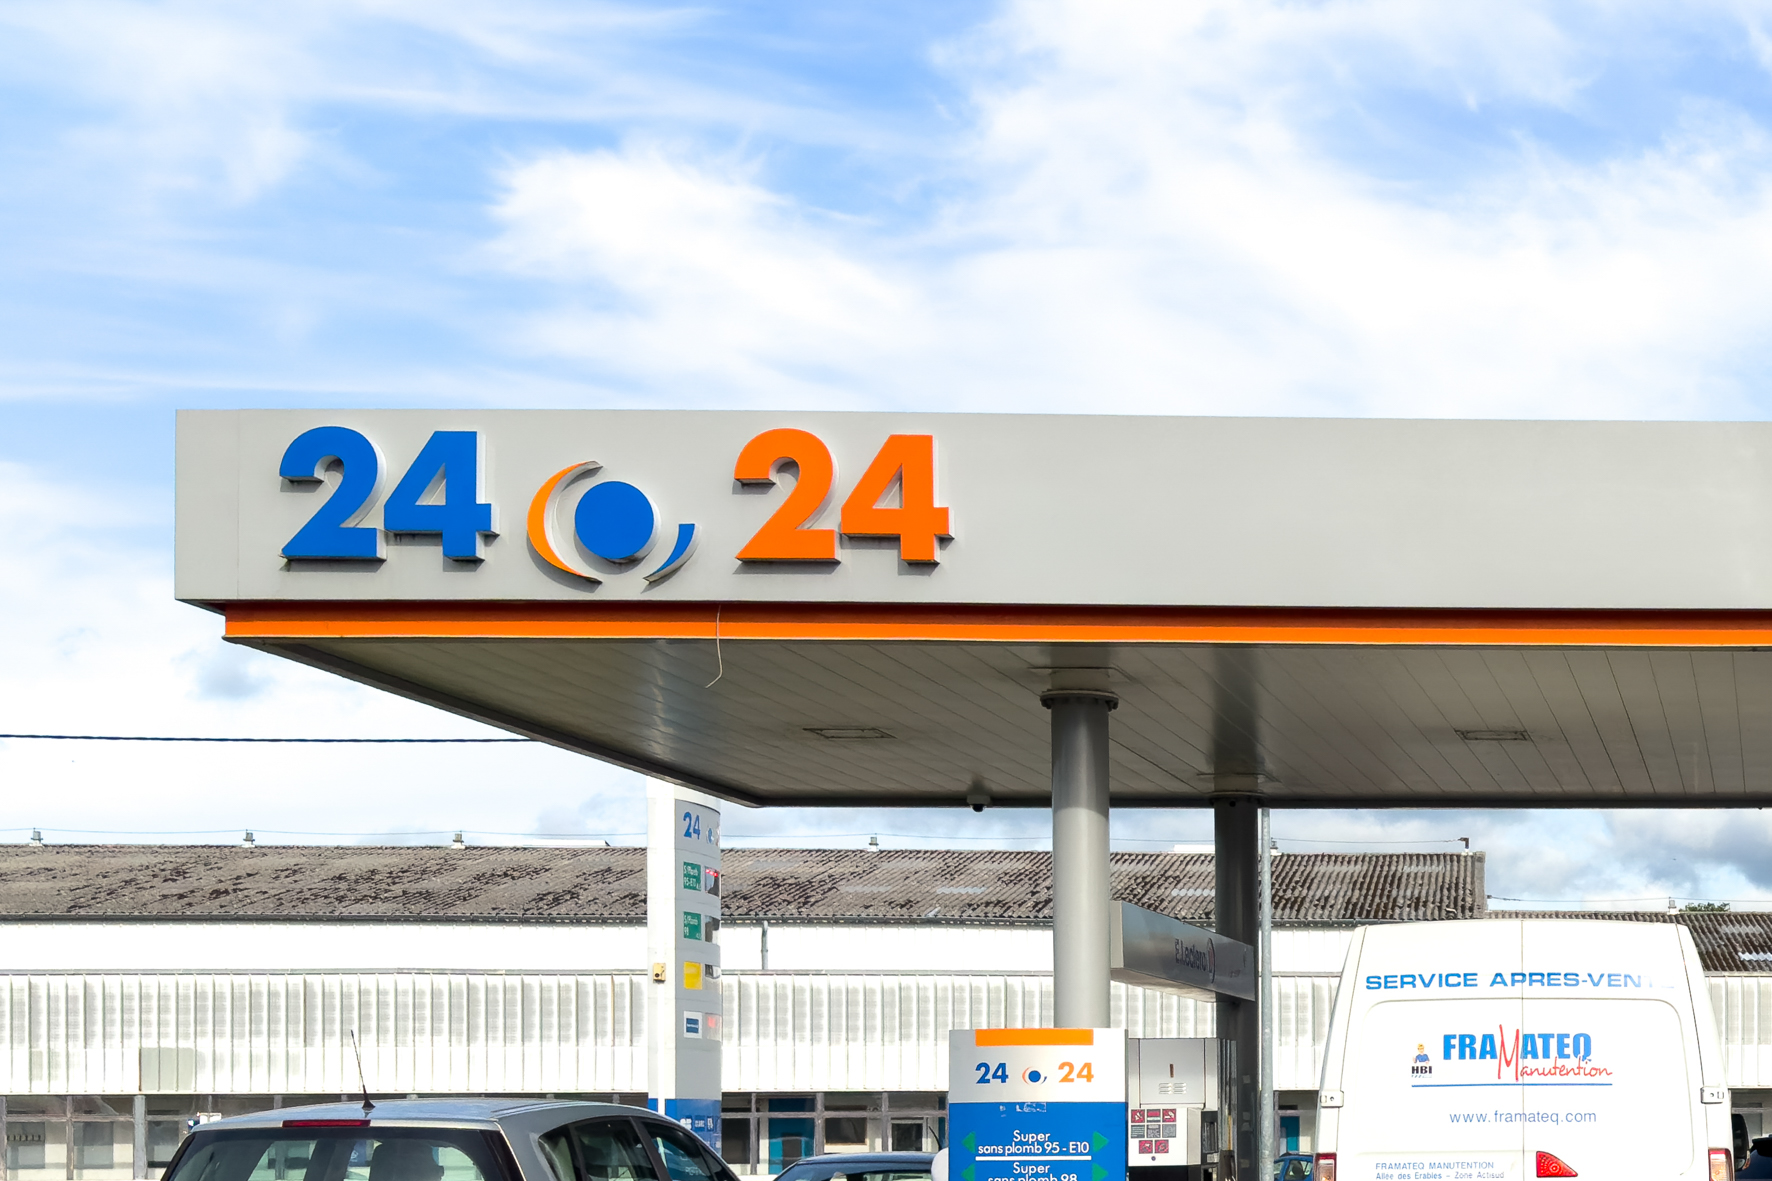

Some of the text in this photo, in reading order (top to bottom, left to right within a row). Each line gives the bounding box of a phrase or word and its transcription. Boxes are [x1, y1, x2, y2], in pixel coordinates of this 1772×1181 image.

[279, 425, 951, 563] 24 24
[683, 811, 701, 840] 24
[1366, 972, 1674, 990] SERVICE APRES-VEN
[1443, 1026, 1592, 1080] FRAMATEQ
[975, 1061, 1094, 1084] 24 24
[1411, 1065, 1433, 1075] HBI
[1449, 1110, 1597, 1125] www.framateq.com
[1013, 1129, 1051, 1144] Super
[978, 1144, 1003, 1154] sans
[1005, 1141, 1043, 1156] plomb
[1044, 1141, 1060, 1154] 95
[1069, 1141, 1090, 1154] E10
[1013, 1162, 1051, 1176] Super
[1375, 1161, 1494, 1170] FRAMATEQ MANUTENTION
[1397, 1172, 1411, 1180] des
